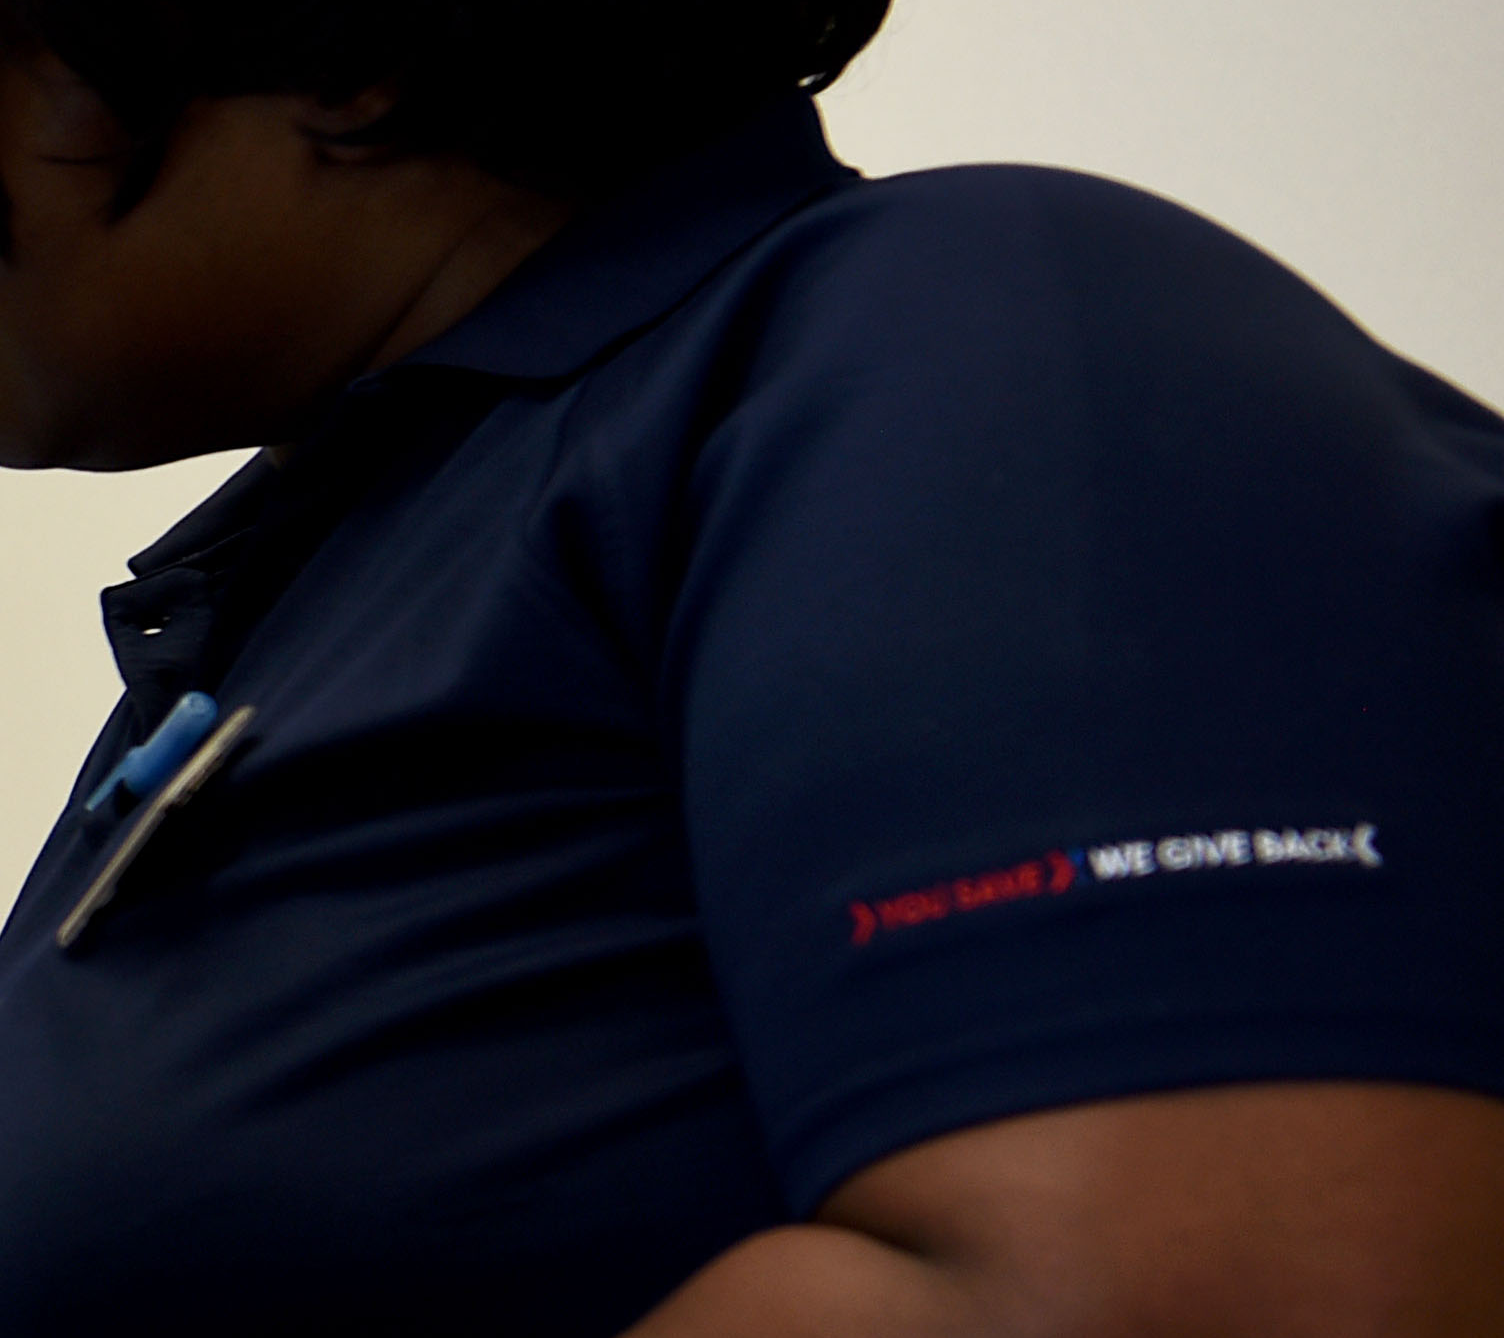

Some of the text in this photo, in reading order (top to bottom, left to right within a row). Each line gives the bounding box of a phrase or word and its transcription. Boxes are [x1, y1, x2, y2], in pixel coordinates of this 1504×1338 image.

[1089, 841, 1156, 881] WE
[1156, 830, 1252, 870] GIVE
[1252, 828, 1350, 864] BACK
